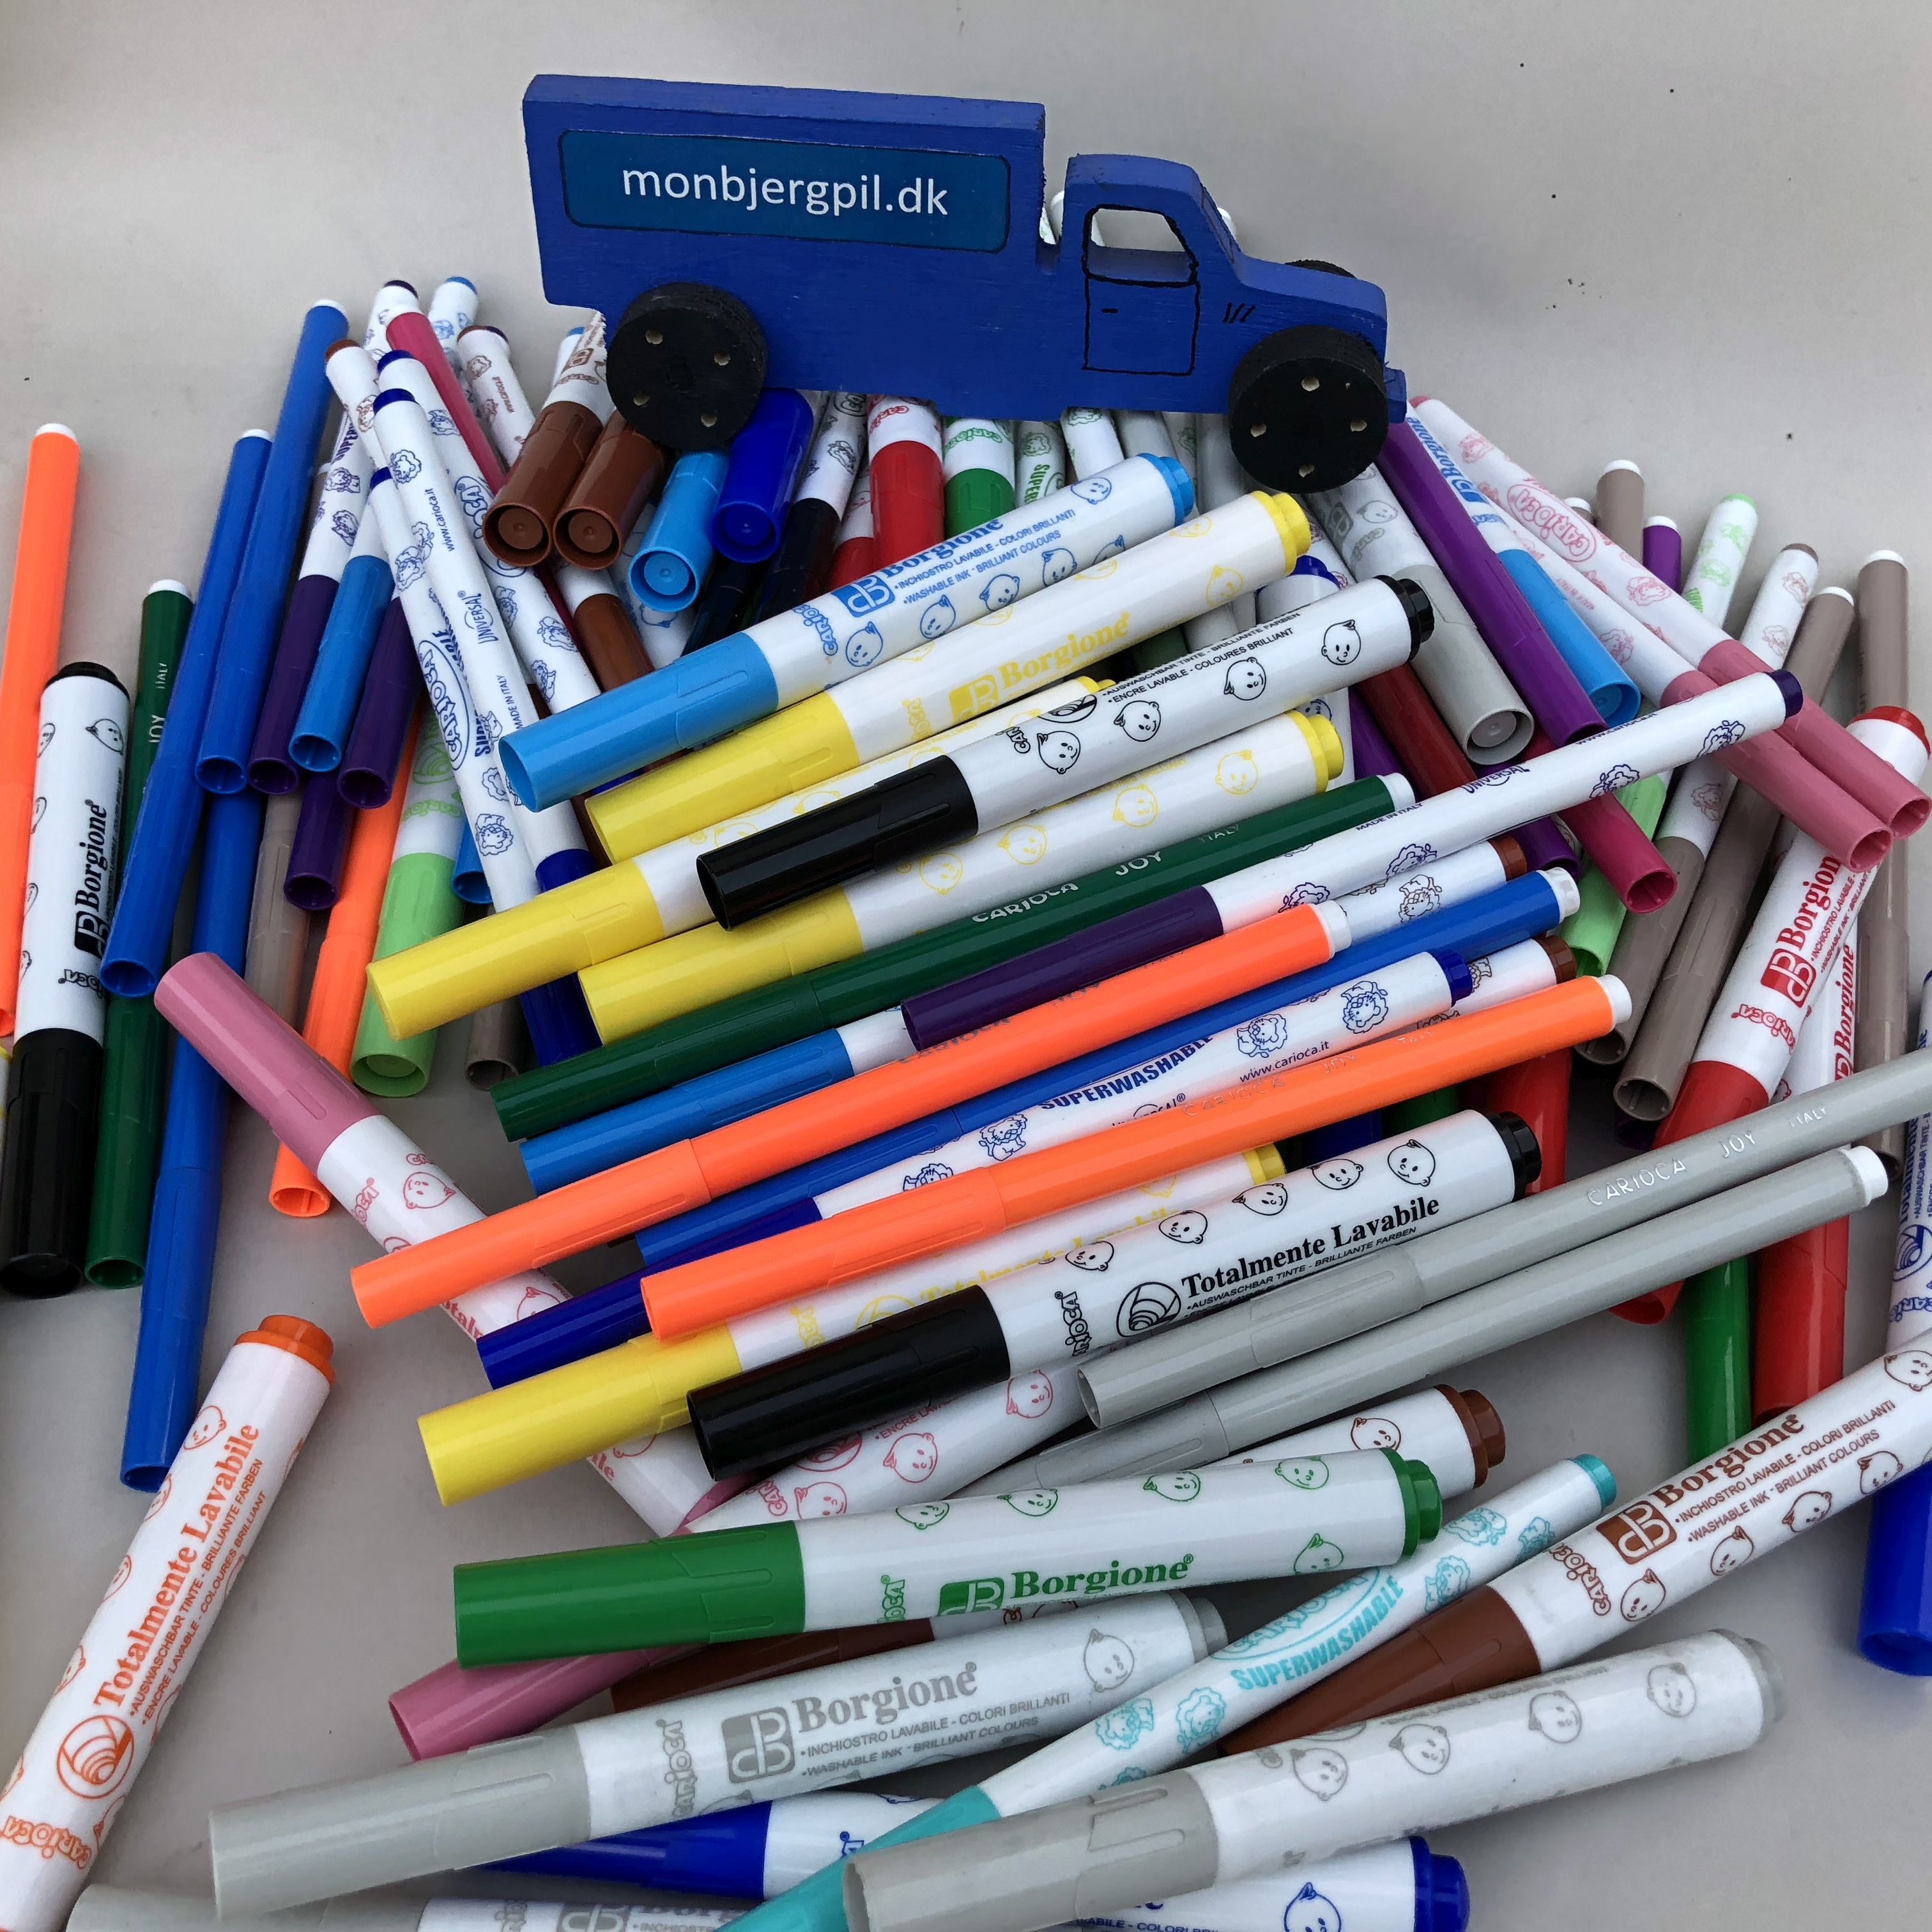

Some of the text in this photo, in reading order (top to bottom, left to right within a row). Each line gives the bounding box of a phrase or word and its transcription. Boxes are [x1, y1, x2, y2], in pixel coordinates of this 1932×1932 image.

[622, 165, 948, 216] monbjergpil.dk
[424, 487, 455, 552] www.carioca.it
[898, 560, 953, 589] INCHIOSTRO
[954, 544, 994, 566] LAVABILE
[999, 529, 1031, 547] COLORI
[1031, 509, 1076, 536] BRILLANTI
[906, 530, 1062, 604] WASHABLE INK BRILLIANT COLOURS
[1112, 627, 1294, 703] ENCRE LAVABLE COLOURES BRILLIANT
[1356, 817, 1385, 831] MADE
[1397, 802, 1423, 816] ITALY
[75, 802, 108, 912] Borgione
[1115, 850, 1162, 876] JOY
[1775, 855, 1842, 951] Borgion
[1811, 910, 1838, 961] INCHIOSTRO
[1036, 1036, 1213, 1110] SUPERWASHABLE
[1239, 1041, 1330, 1083] www.carioca.it
[1586, 1156, 1687, 1206] CARIOCA
[1718, 1129, 1757, 1159] JOY
[1181, 1238, 1326, 1299] Totalmente
[1331, 1196, 1439, 1249] Lavabile
[1191, 1275, 1274, 1310] AUSWASCHBAR
[1276, 1265, 1307, 1281] TINTE
[1314, 1241, 1374, 1268] BRILLIANTE
[1376, 1226, 1417, 1246] FARBEN
[1647, 1414, 1805, 1508] Borgione
[1680, 1480, 1746, 1523] INCHIOSTRO
[1747, 1452, 1796, 1486] LAVABILE
[1800, 1427, 1843, 1455] COLORI
[1842, 1399, 1896, 1435] BRILLANTI
[1690, 1429, 1880, 1542] WASHABLE INK BRILLIANT COLOURS
[93, 1425, 259, 1707] Totalmente Lavabile
[132, 1458, 263, 1712] AUSWASCHBAR TINTE BRILLIANTE FARBEN
[1010, 1559, 1191, 1600] Borgione
[144, 1674, 172, 1720] ENCRE
[168, 1620, 200, 1674] LAVABLE
[201, 1548, 237, 1613] COLOURES
[1230, 1574, 1404, 1690] SUPERWASHABLE
[792, 1665, 978, 1733] Borgione
[808, 1730, 888, 1758] INCHIOSTRO
[891, 1717, 949, 1740] LAVABILE
[959, 1706, 1006, 1725] COLORI
[1009, 1692, 1071, 1714] BRILLANTI
[806, 1715, 1039, 1777] WASHABLE INK BRILLIANT COLOURS
